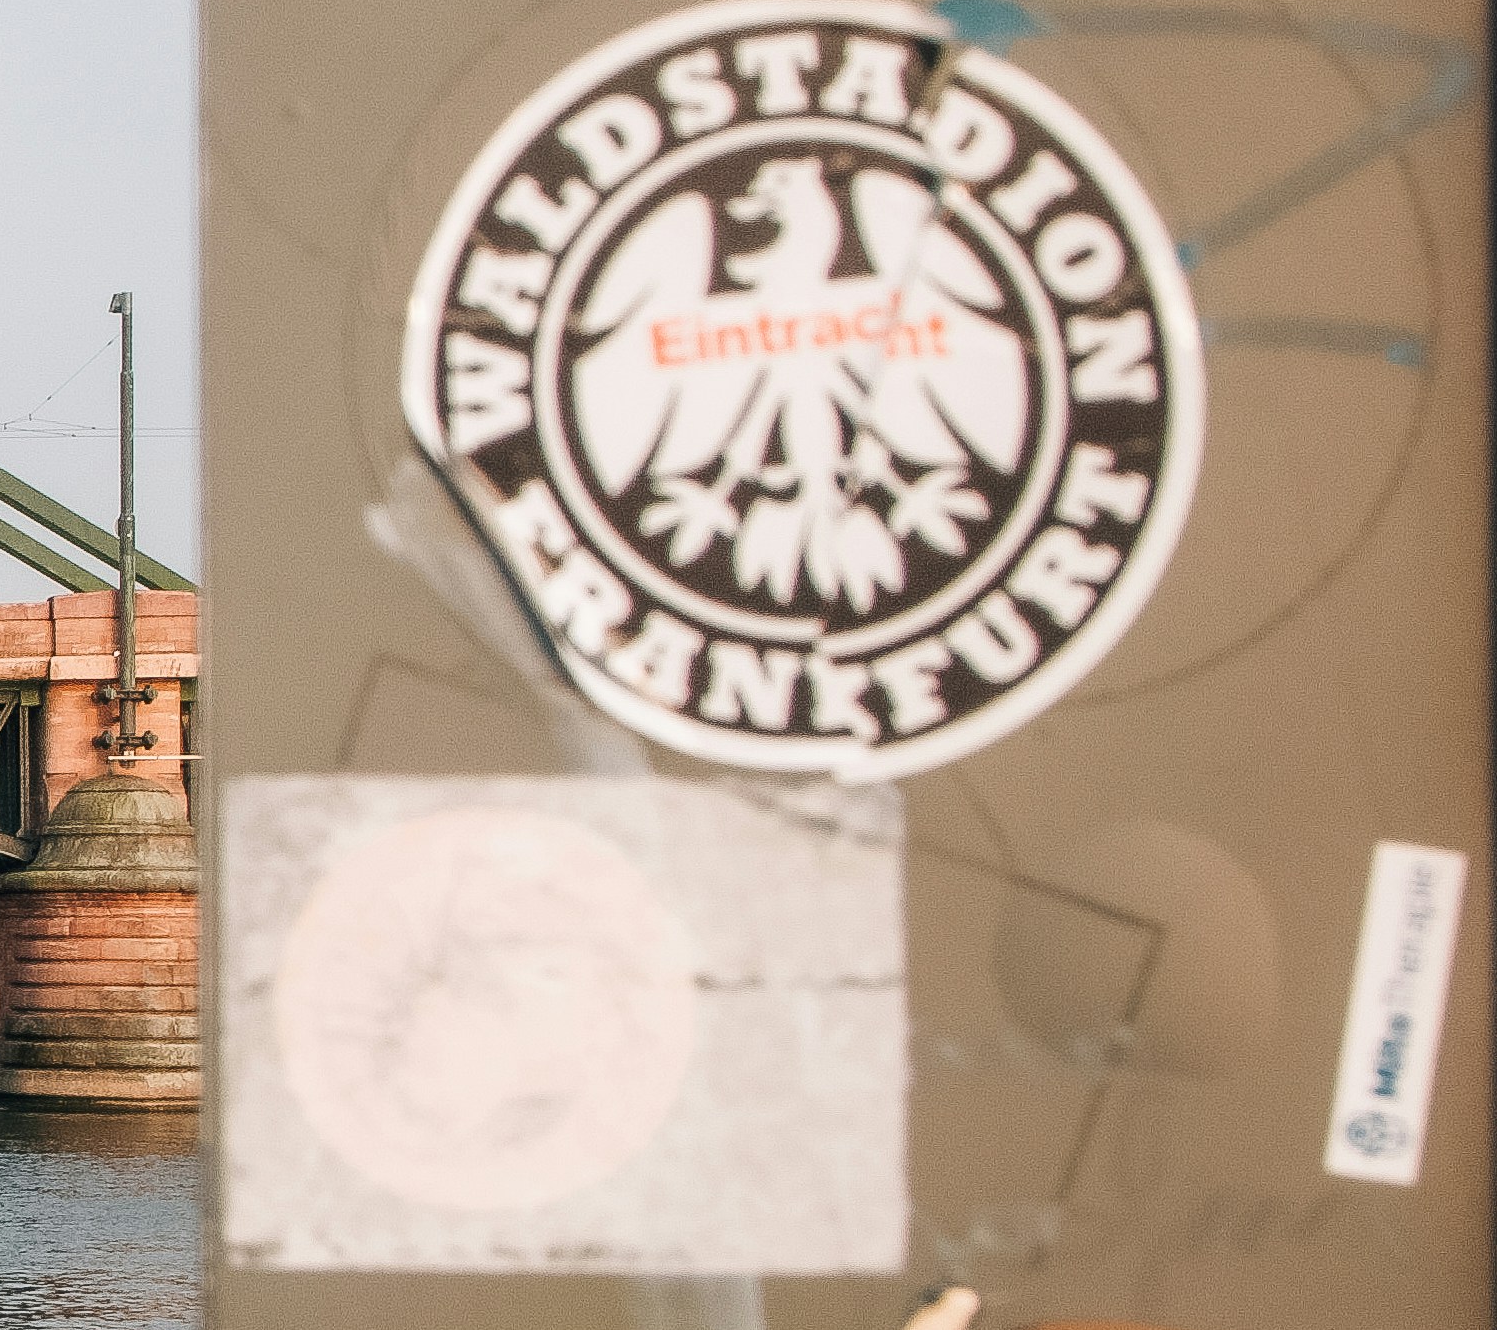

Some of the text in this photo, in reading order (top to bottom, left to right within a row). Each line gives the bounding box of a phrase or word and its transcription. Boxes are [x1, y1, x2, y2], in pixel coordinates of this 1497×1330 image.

[442, 29, 1161, 457] WALDSTADION
[648, 289, 952, 373] Eintracht
[496, 445, 1152, 747] FRANKFURT
